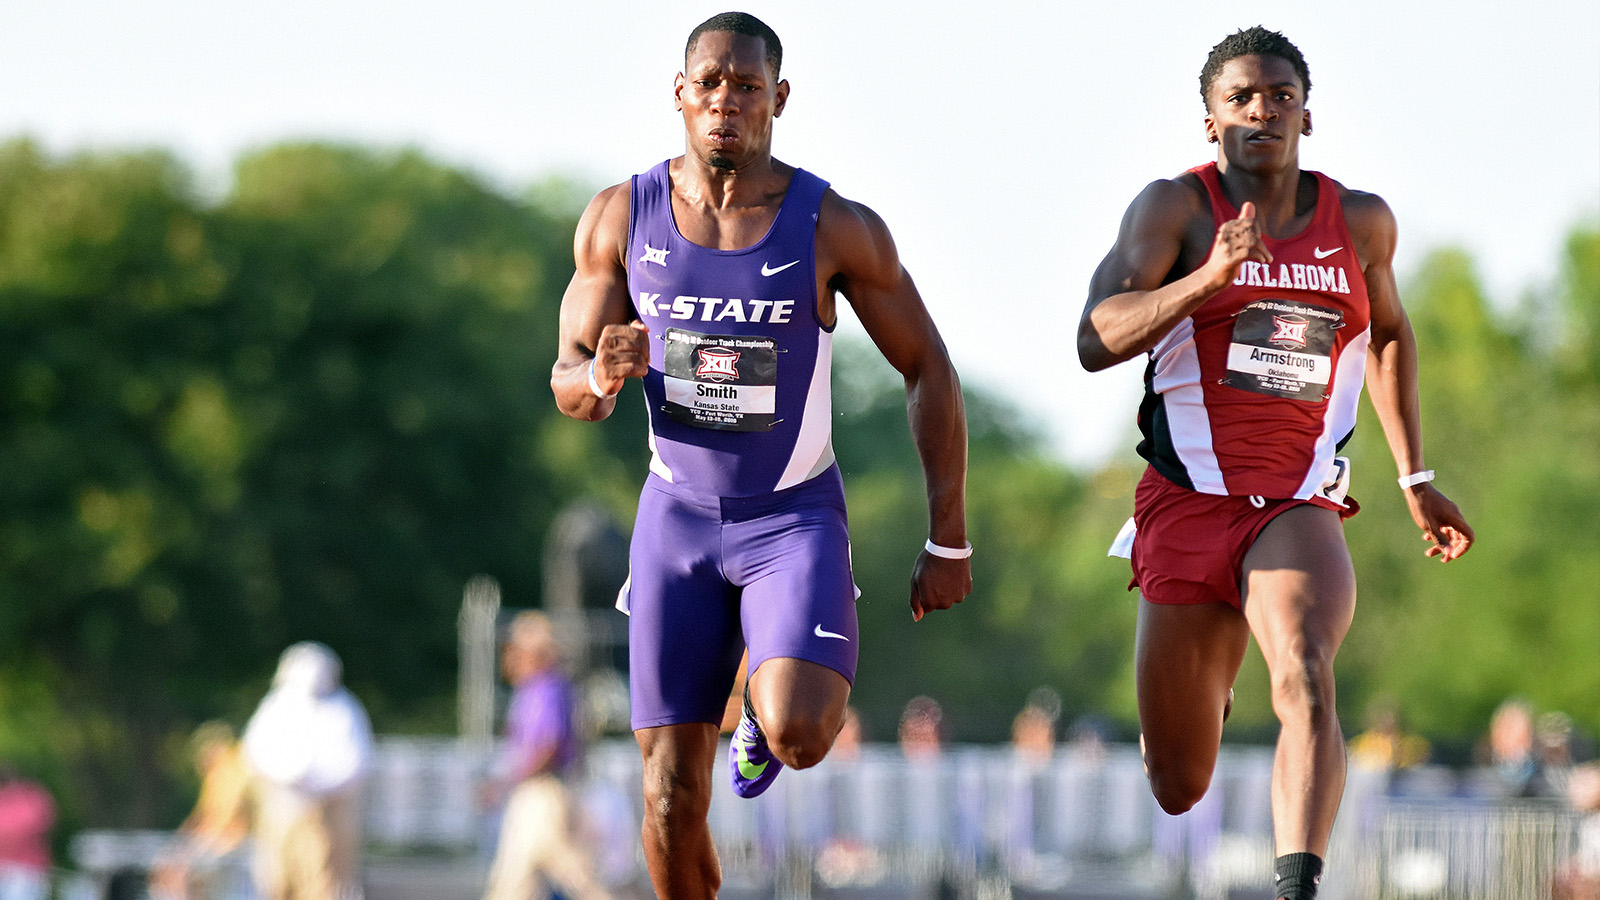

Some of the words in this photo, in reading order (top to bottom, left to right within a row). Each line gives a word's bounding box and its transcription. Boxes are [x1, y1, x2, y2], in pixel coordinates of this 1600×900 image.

[639, 291, 795, 324] K-STATE
[697, 337, 718, 346] Outdoor
[719, 338, 735, 347] Track
[735, 340, 774, 349] Championship
[1250, 347, 1315, 372] Armstrong
[1268, 368, 1299, 379] Oklahoma
[696, 384, 738, 399] Smith
[693, 400, 719, 410] Kansas
[720, 403, 740, 412] State
